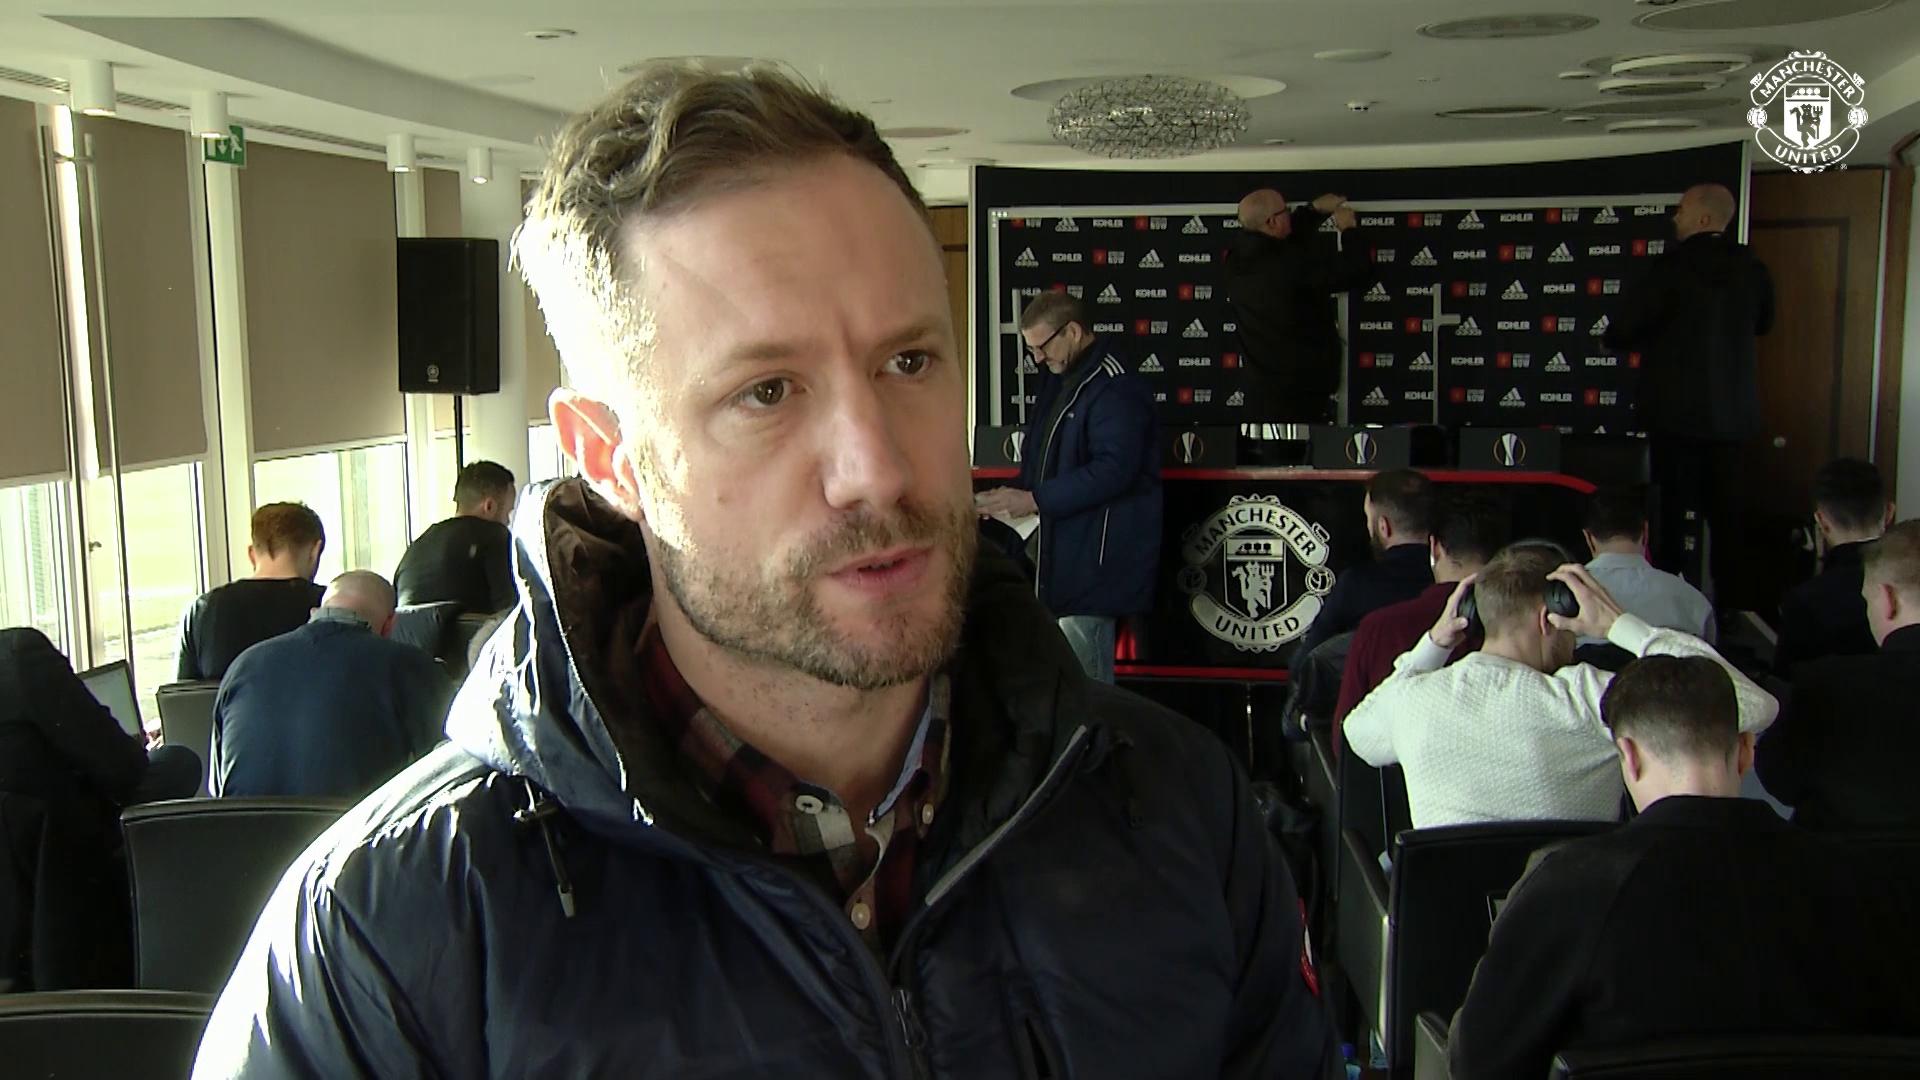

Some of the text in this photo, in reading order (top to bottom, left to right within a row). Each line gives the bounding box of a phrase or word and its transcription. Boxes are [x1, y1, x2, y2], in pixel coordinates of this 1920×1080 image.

[1361, 218, 1394, 226] KOHLER
[1500, 213, 1533, 222] KOHLER
[1093, 218, 1123, 228] KOHLER
[1453, 251, 1486, 259] KOHLER
[1589, 246, 1620, 256] KOHLER
[1053, 253, 1082, 262] KOHLER
[1179, 254, 1210, 262] KOHLER
[1136, 289, 1166, 297] KOHLER
[1544, 284, 1575, 293] KOHLER
[1093, 324, 1124, 332] KOHLER
[1360, 322, 1393, 330] KOHLER
[1497, 321, 1530, 330] KOHLER
[1179, 358, 1210, 366] KOHLER
[1451, 357, 1484, 365] KOHLER
[1586, 357, 1616, 366] KOHLER
[1540, 393, 1572, 402] KOHLER
[1196, 507, 1316, 557] MANCHESTER
[1215, 614, 1300, 640] UNITED
